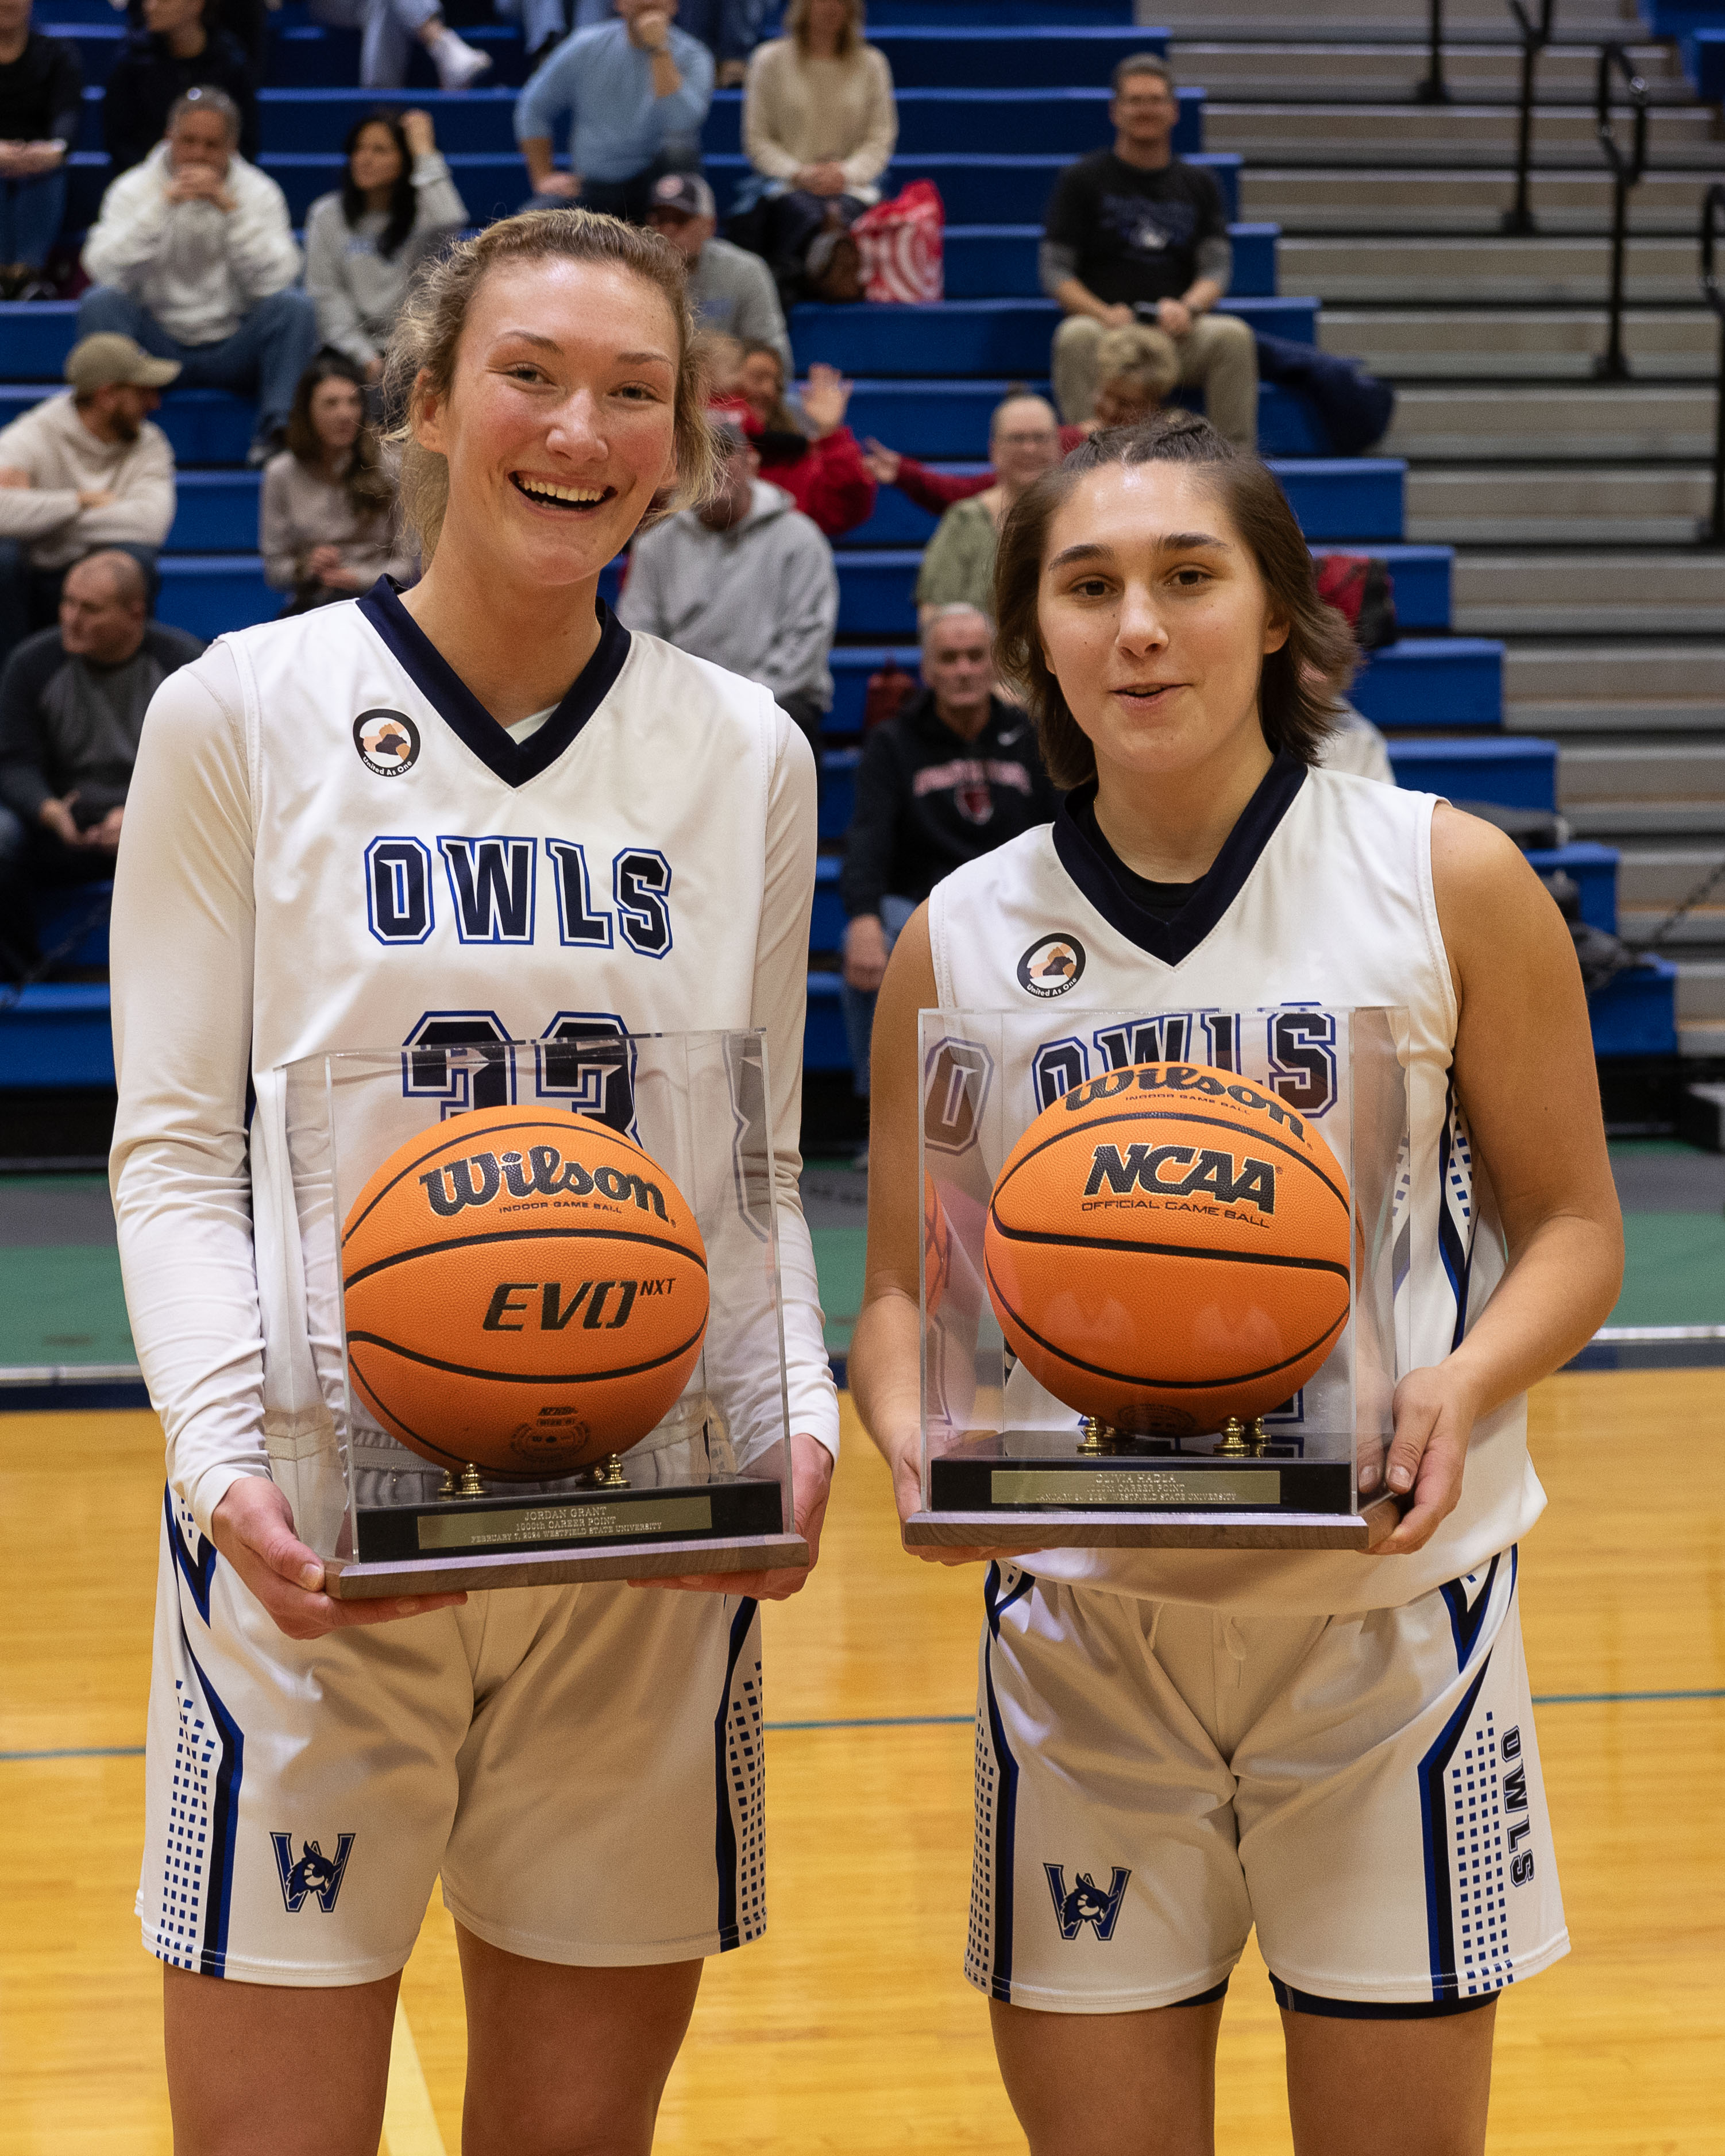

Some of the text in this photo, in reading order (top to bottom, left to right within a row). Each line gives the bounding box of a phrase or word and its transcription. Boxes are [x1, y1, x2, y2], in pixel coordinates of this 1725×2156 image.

[362, 756, 384, 775] United
[397, 760, 412, 772] One
[364, 835, 673, 960] OWLS
[1026, 984, 1050, 996] United
[1063, 977, 1077, 991] One
[1063, 1066, 1306, 1143] Wilson
[1125, 1094, 1250, 1115] INDOOR GAME BALL
[419, 1145, 670, 1223] Wilson
[1082, 1142, 1276, 1215] NCAA
[499, 1201, 549, 1214] INDOOR
[593, 1202, 622, 1214] BALL
[1082, 1200, 1270, 1228] OFFICIAL GAME BALL
[482, 1278, 677, 1331] EVO NXT
[1118, 1484, 1154, 1493] CAREER
[1157, 1484, 1185, 1493] POINT
[516, 1516, 616, 1532] 1000th CAREER POINT
[524, 1506, 607, 1521] JORDAN GRANT
[471, 1533, 512, 1543] FEBRUARY
[523, 1531, 541, 1540] 2024
[543, 1528, 586, 1538] WESTFIELD
[589, 1526, 613, 1535] STATE
[615, 1522, 662, 1533] UNIVERSITY
[1501, 1725, 1535, 1888] OWLS
[269, 1832, 356, 1913] W
[1043, 1863, 1132, 1941] W
